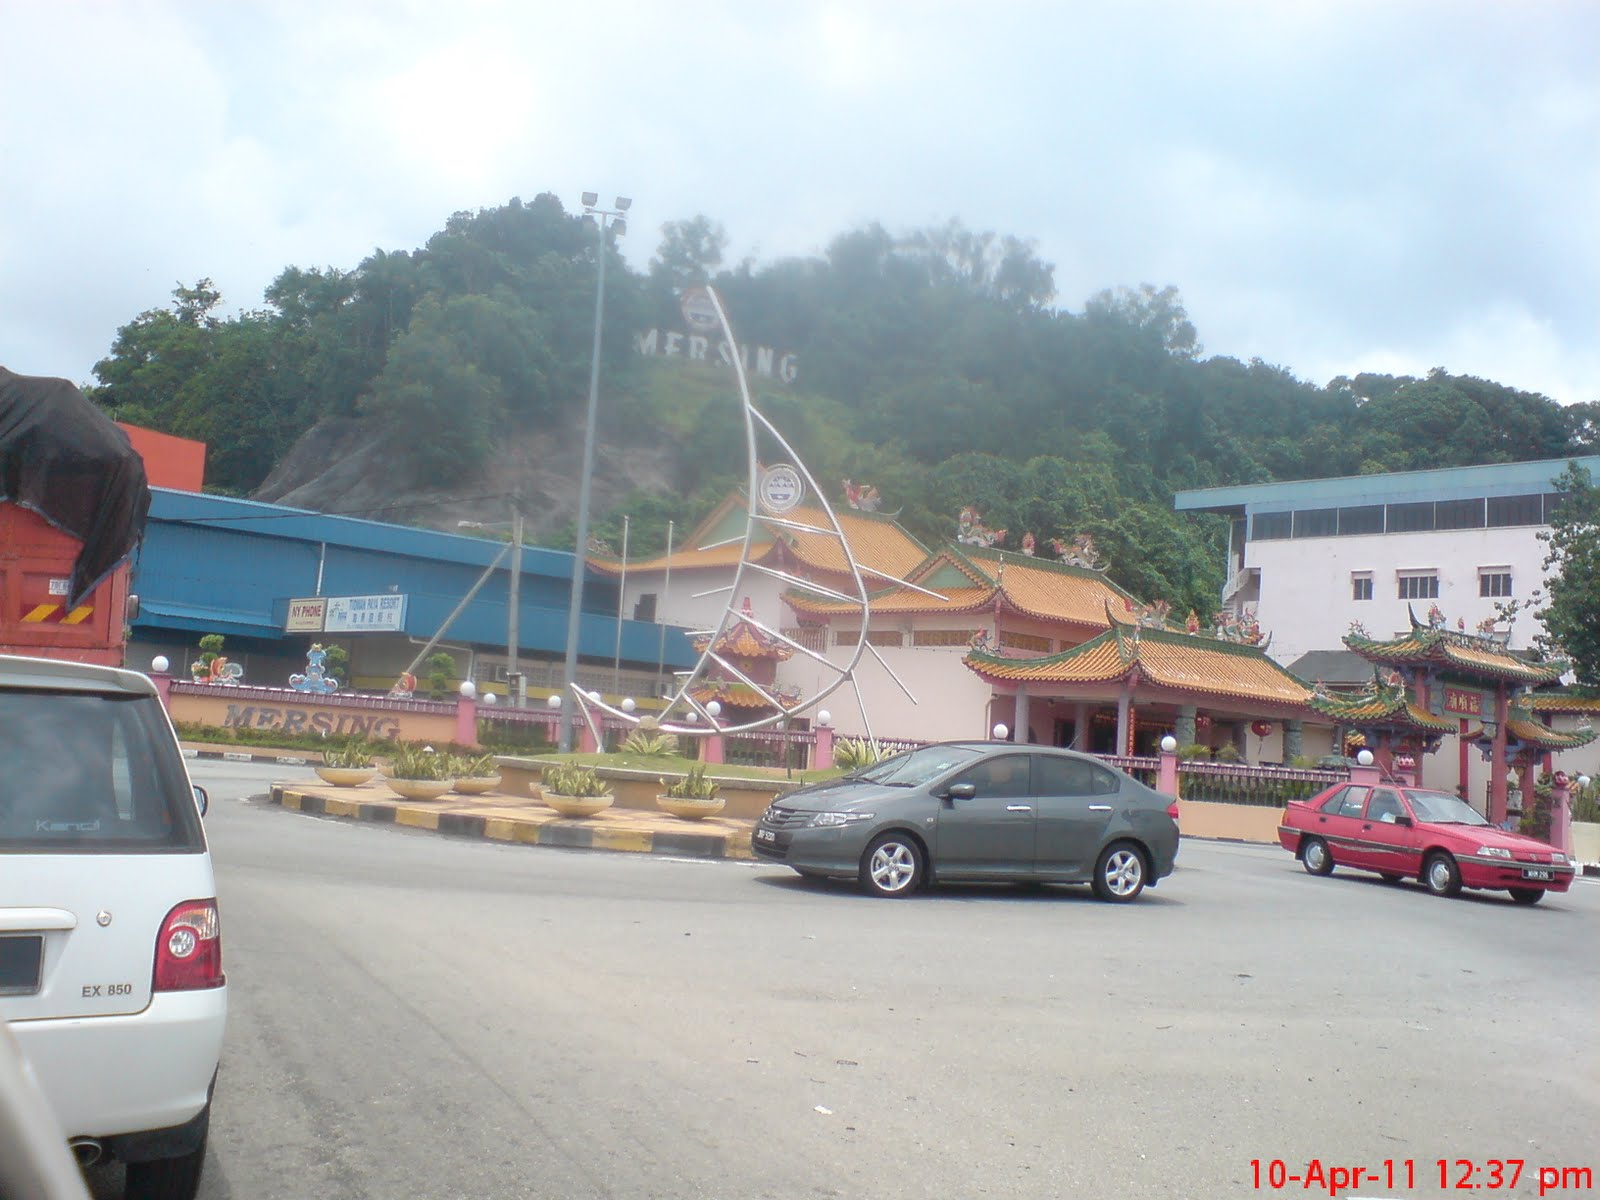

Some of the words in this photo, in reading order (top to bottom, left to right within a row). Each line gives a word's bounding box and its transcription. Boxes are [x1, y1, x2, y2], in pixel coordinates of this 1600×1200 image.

[632, 328, 798, 384] MERSING
[301, 604, 322, 618] PHONE
[380, 597, 400, 610] RESORT
[223, 703, 401, 741] MERSING
[82, 985, 101, 998] EX
[107, 983, 132, 996] 850
